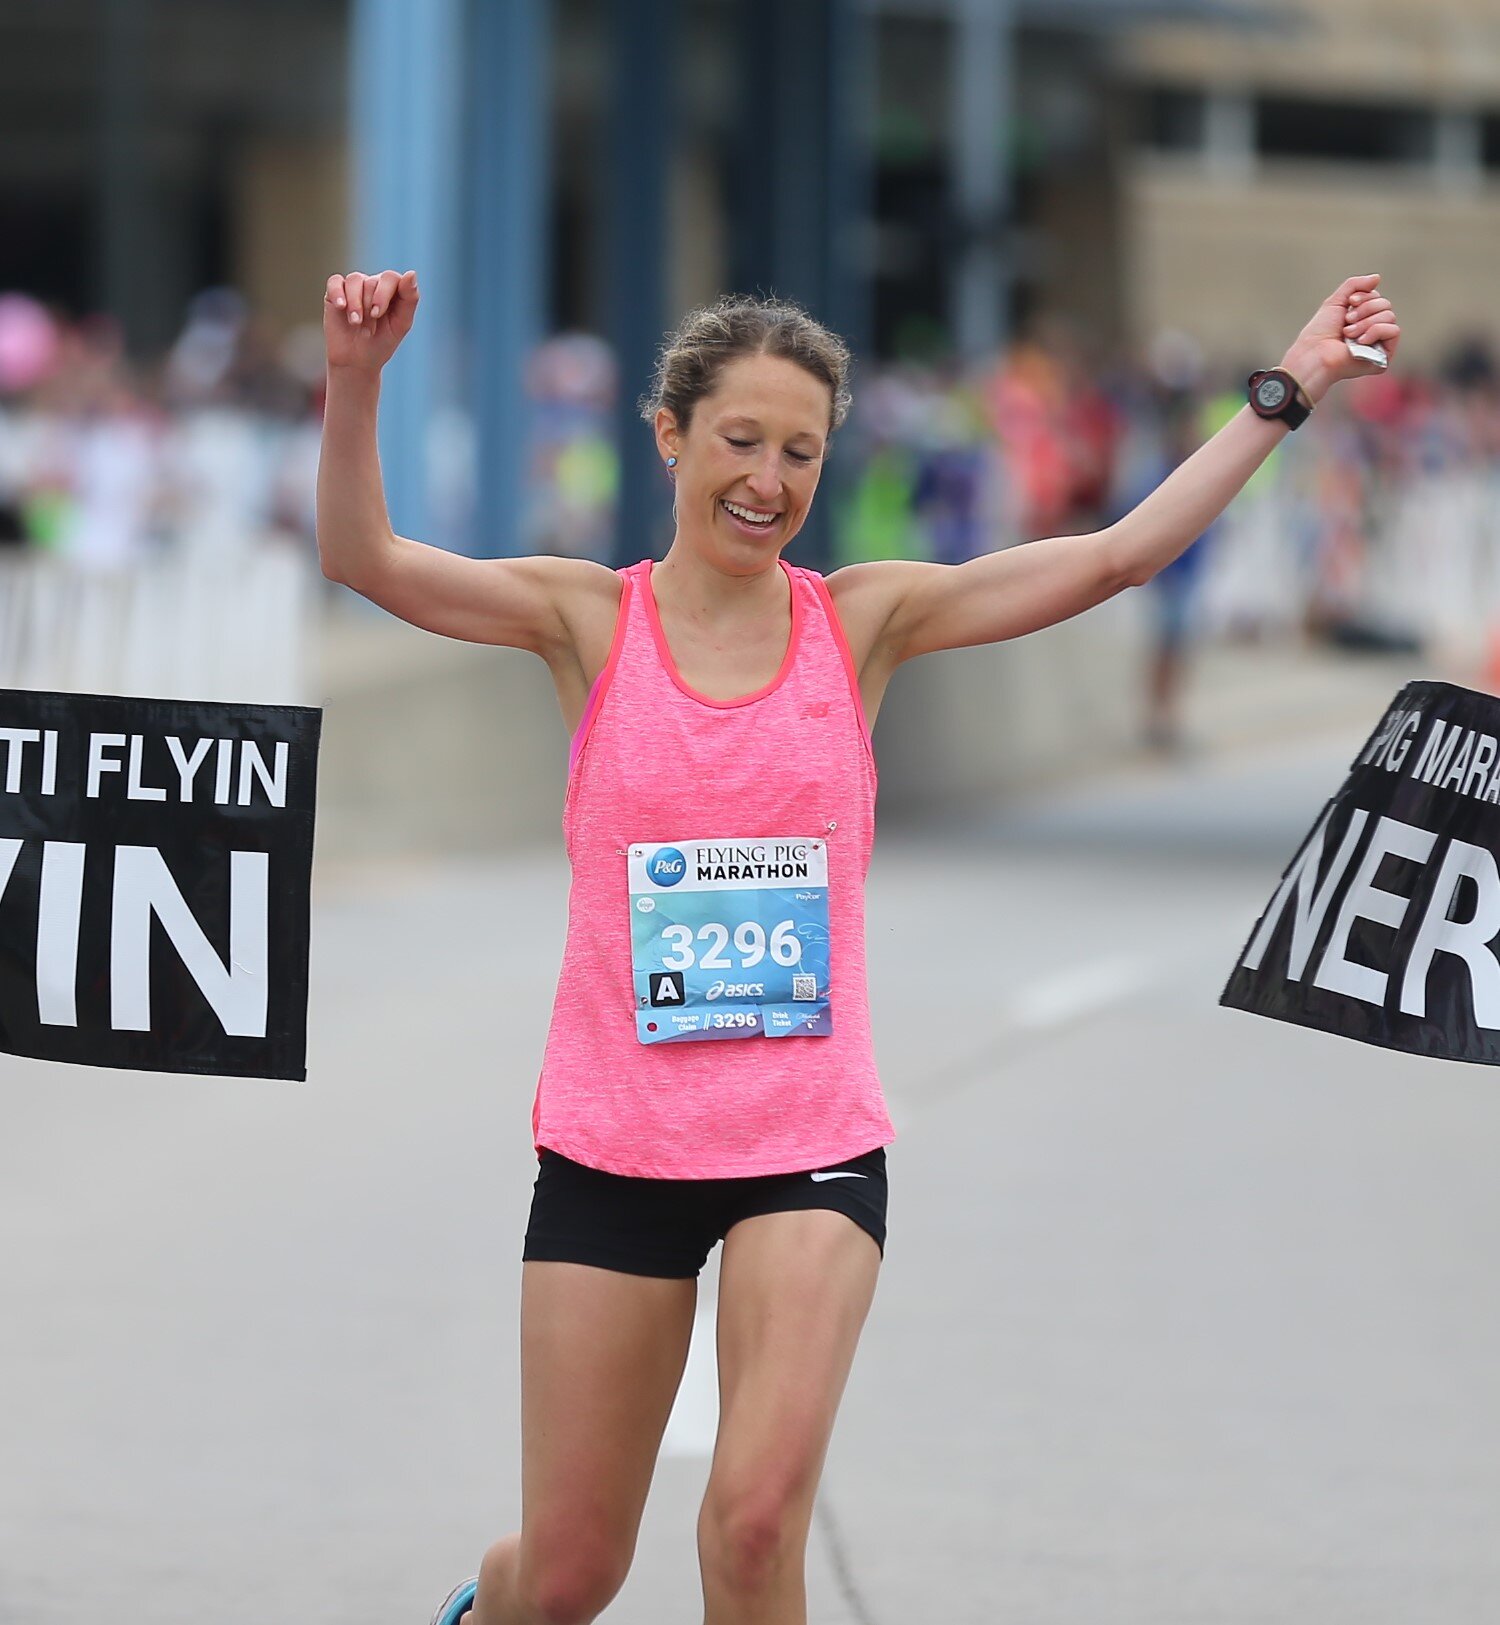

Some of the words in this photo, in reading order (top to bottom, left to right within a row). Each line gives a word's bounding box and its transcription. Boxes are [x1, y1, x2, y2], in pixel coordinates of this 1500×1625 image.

[86, 732, 289, 808] FLYIN
[696, 846, 766, 864] FLYING
[775, 844, 807, 862] PIG
[654, 859, 683, 874] P&G
[697, 863, 808, 881] MARATHON
[1242, 802, 1500, 1030] NER
[0, 838, 269, 1038] IN
[661, 920, 801, 971] 3296
[656, 976, 680, 1001] A
[671, 1015, 700, 1024] Baggage
[678, 1023, 697, 1031] Claim
[713, 1013, 757, 1029] 3296
[772, 1019, 792, 1027] Ticket
